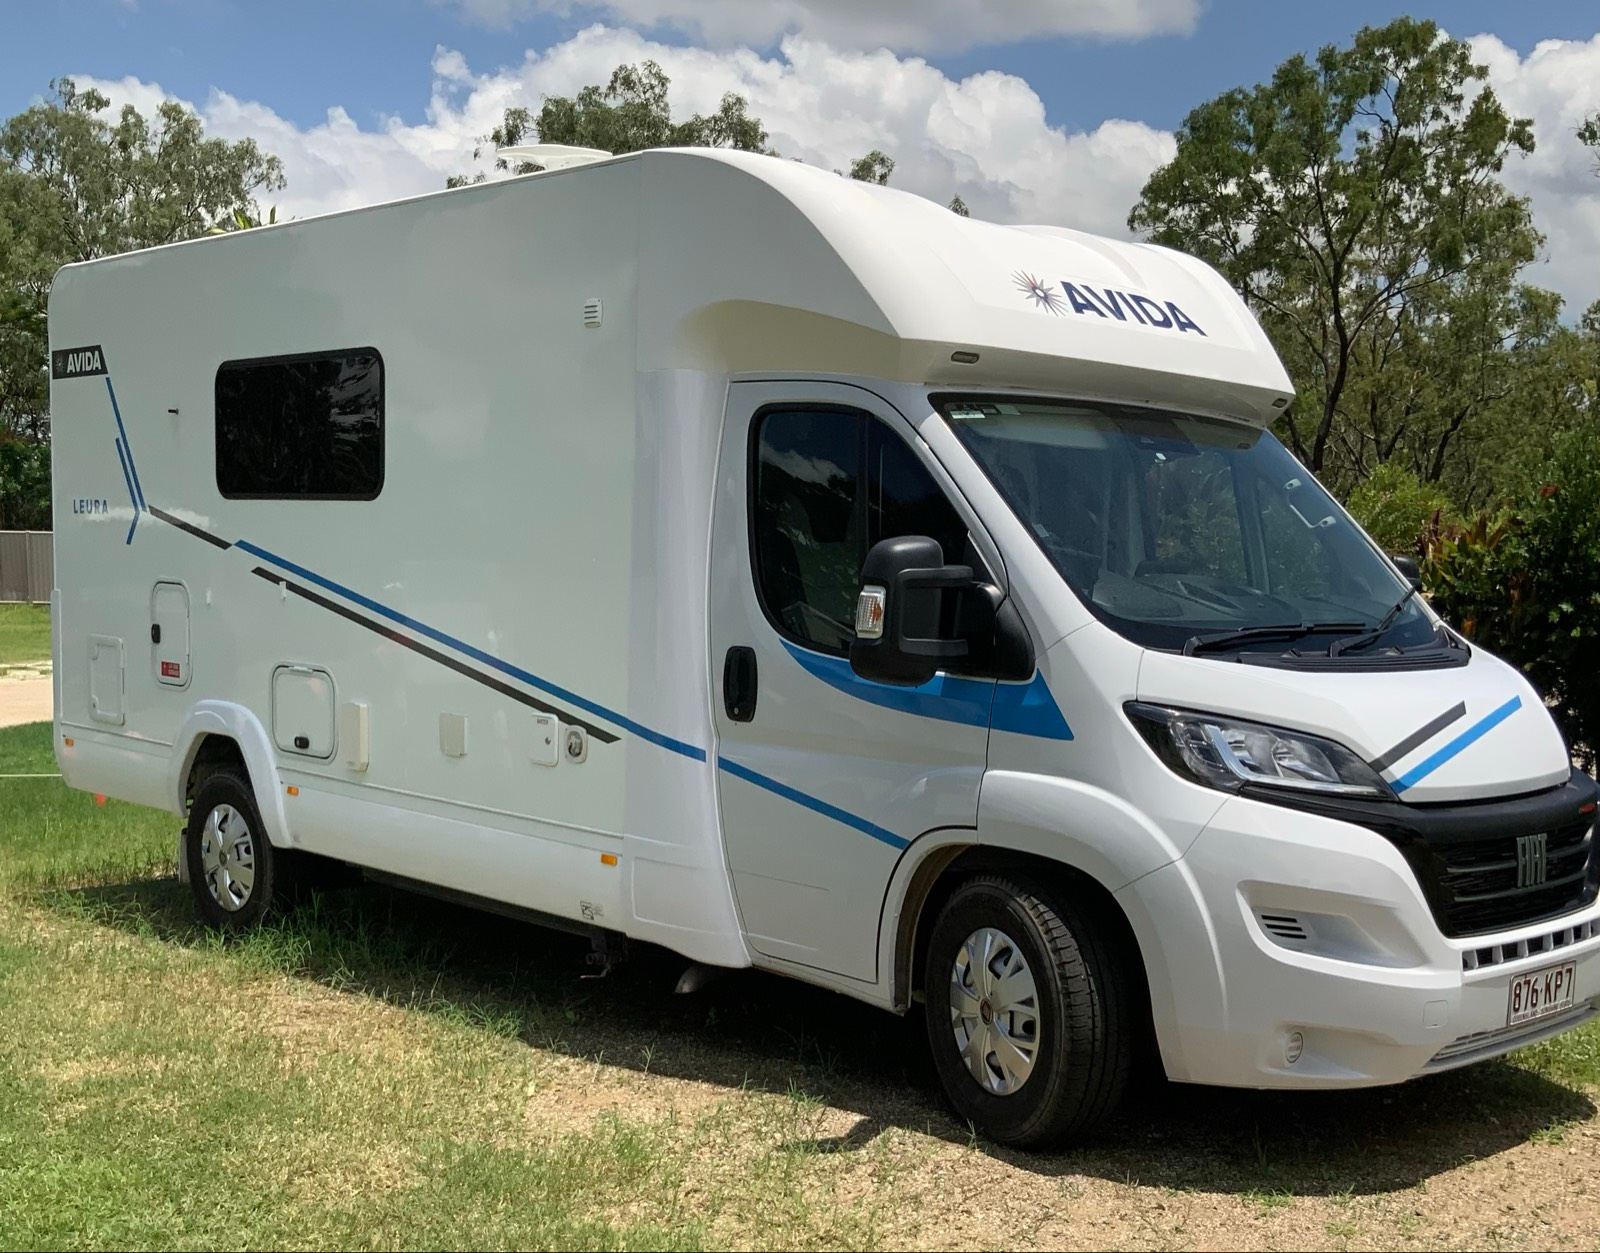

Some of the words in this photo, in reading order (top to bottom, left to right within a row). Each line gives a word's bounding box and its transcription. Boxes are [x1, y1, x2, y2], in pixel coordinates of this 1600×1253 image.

[1060, 280, 1209, 338] AVIDA
[66, 350, 102, 374] AVIDA
[73, 498, 109, 514] LEURA
